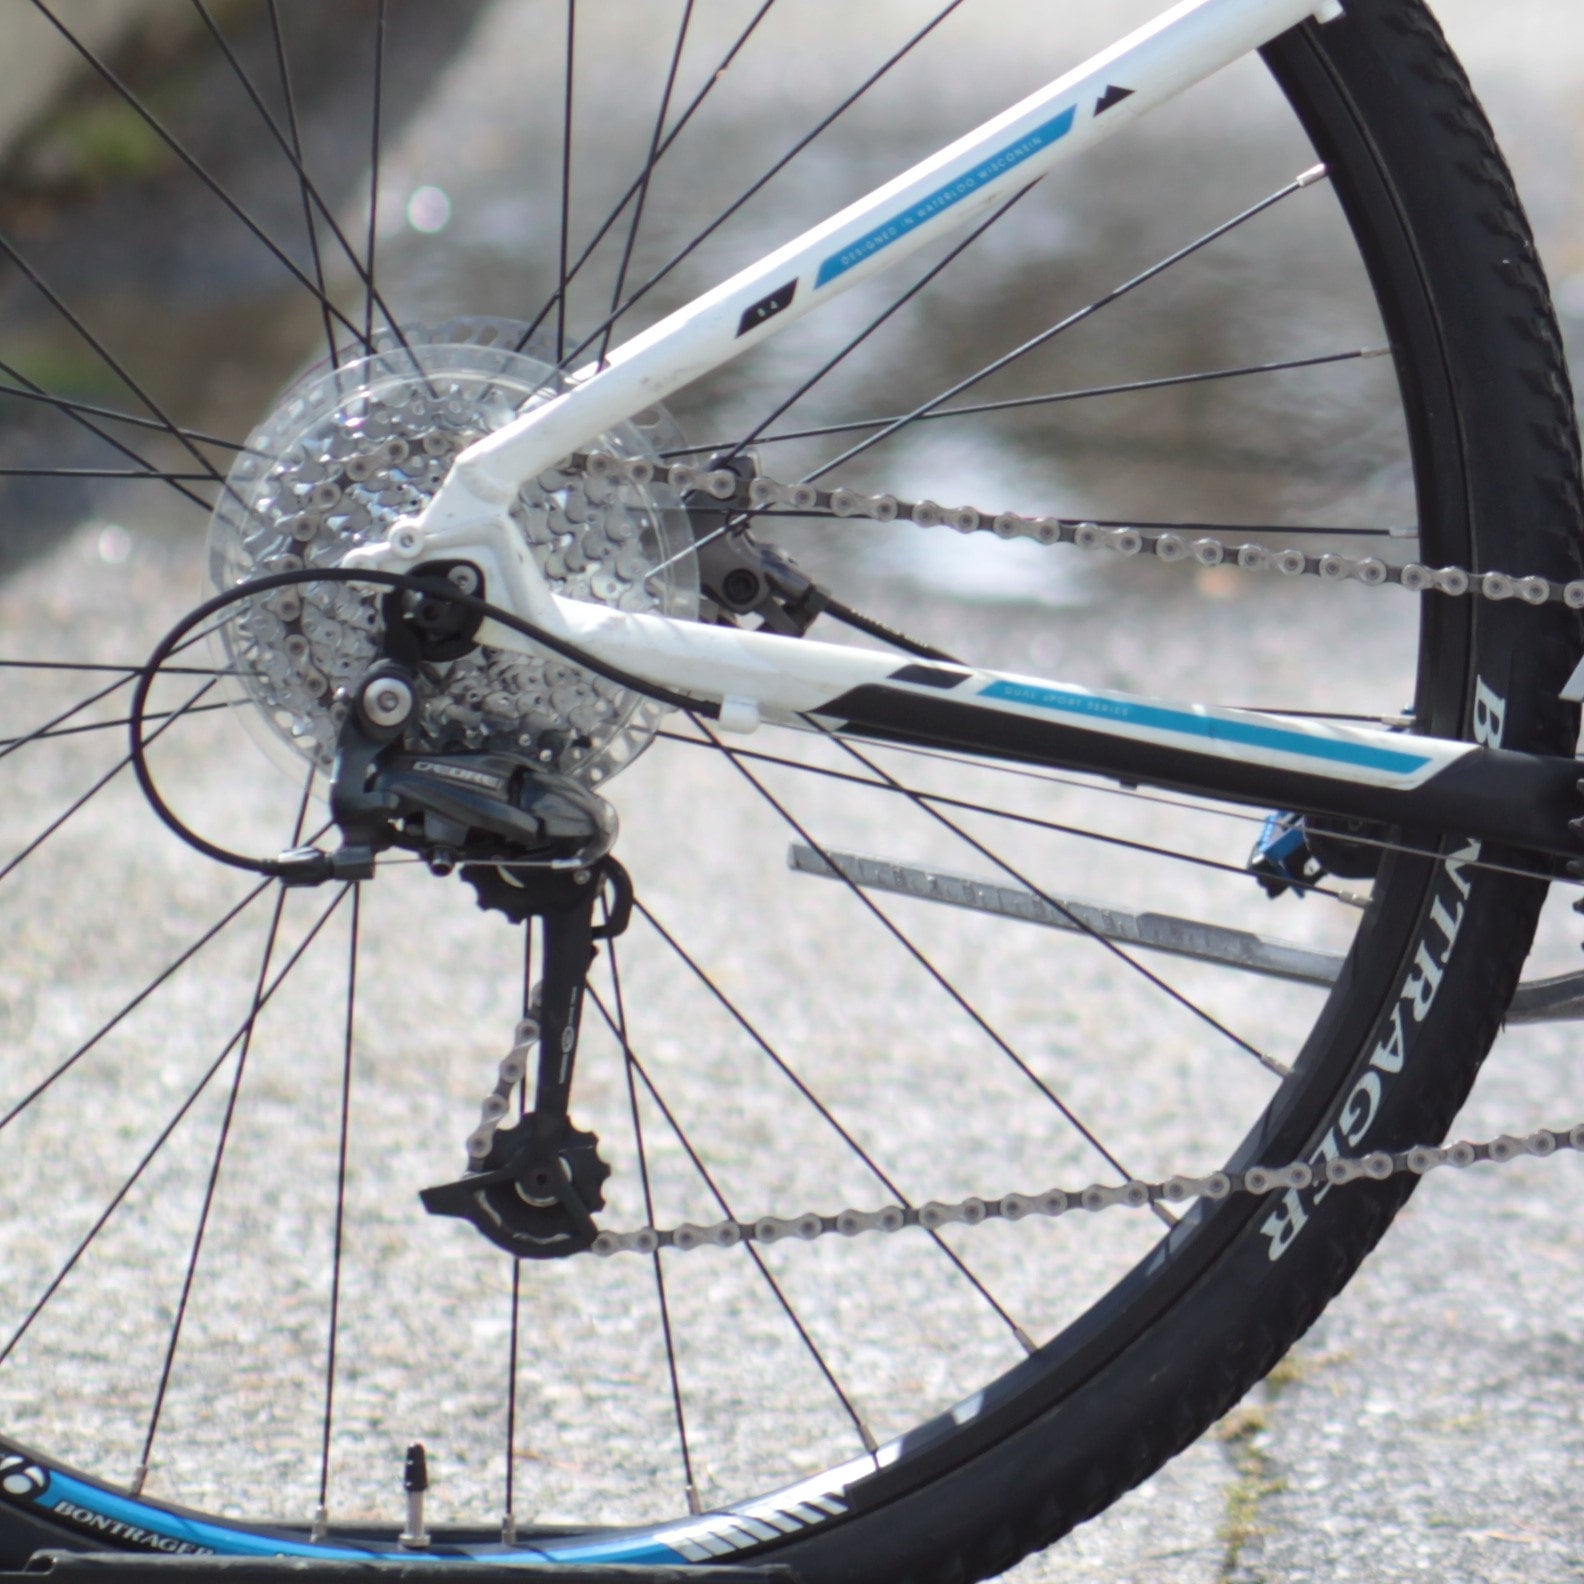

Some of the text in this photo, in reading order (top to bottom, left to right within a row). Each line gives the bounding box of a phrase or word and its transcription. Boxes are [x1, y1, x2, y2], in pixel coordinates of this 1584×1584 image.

[840, 226, 898, 265] DESIGNED
[917, 177, 975, 218] WATERLOO
[977, 135, 1043, 180] WISCONSIN
[1258, 674, 1506, 1262] BNTRAGER
